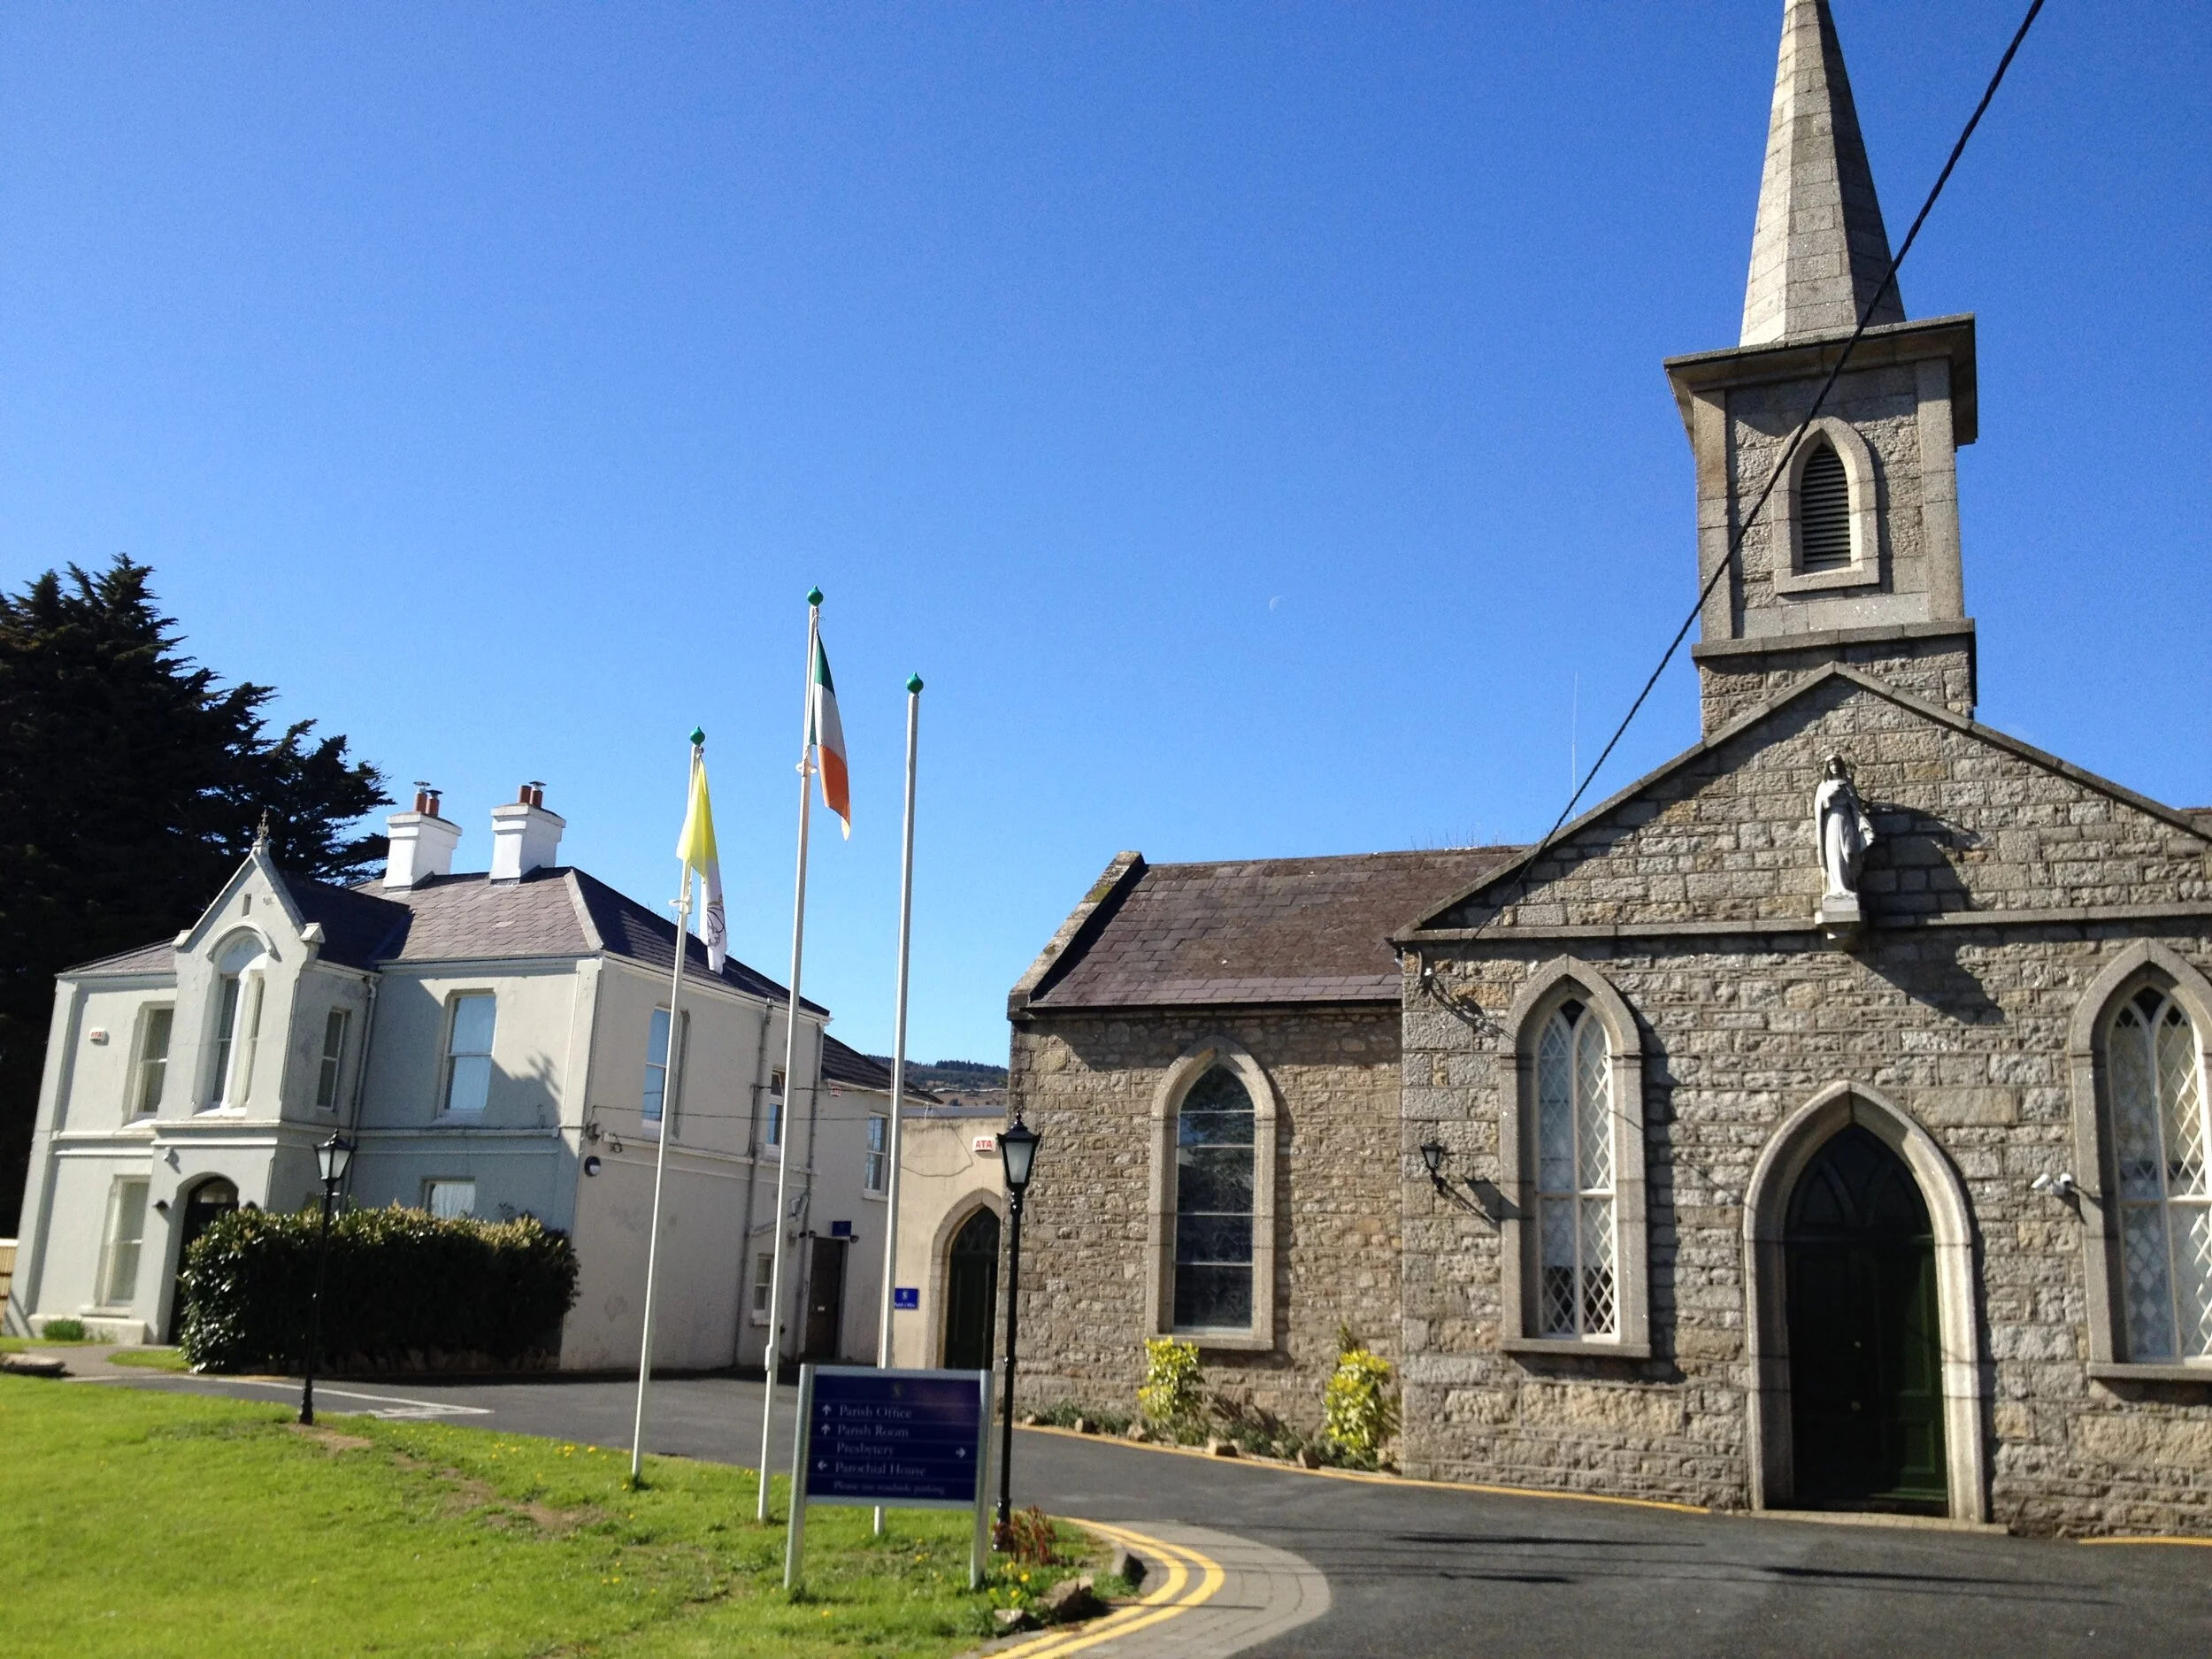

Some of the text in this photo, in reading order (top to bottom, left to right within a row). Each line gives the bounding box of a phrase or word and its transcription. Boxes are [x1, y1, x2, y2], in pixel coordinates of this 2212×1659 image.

[975, 1140, 993, 1149] ATA
[839, 1403, 912, 1419] Parish Office
[837, 1423, 910, 1437] Parish Room
[836, 1441, 894, 1459] Presbytery
[834, 1461, 927, 1477] Parochial House
